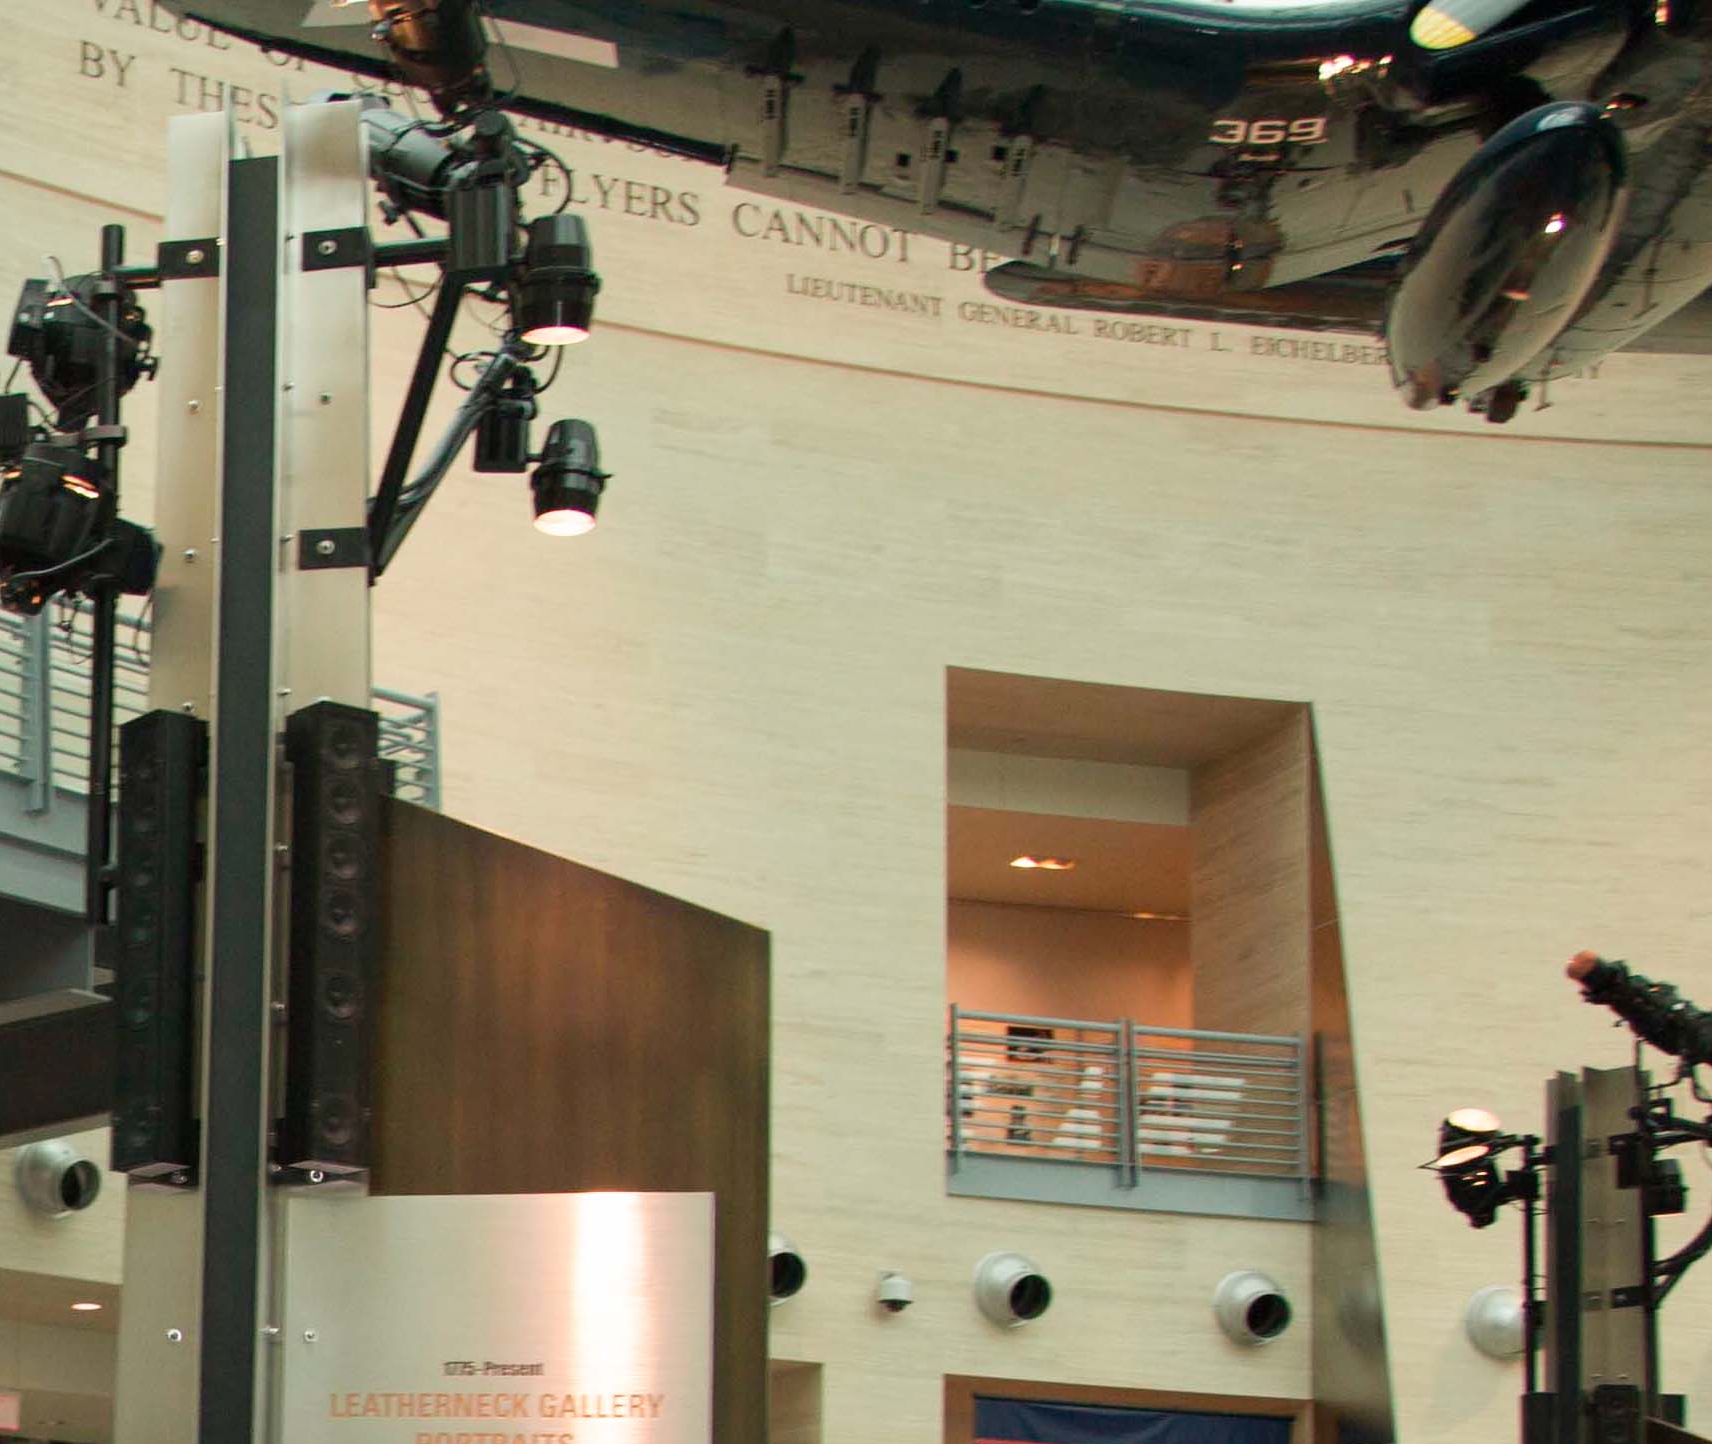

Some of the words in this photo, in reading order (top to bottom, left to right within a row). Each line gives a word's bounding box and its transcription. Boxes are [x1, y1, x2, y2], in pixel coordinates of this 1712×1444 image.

[78, 39, 136, 88] BY
[169, 67, 307, 130] THES
[537, 162, 701, 226] FLYERS
[731, 201, 911, 263] CANNOT
[1209, 116, 1328, 145] 369
[785, 273, 944, 318] LIEUTENANT
[958, 300, 1081, 336] GENERAL
[1093, 318, 1191, 350] ROBERT
[1250, 334, 1393, 368] EICHELBER
[328, 1391, 531, 1419] LEATHERNECK
[537, 1392, 666, 1419] GALLERY
